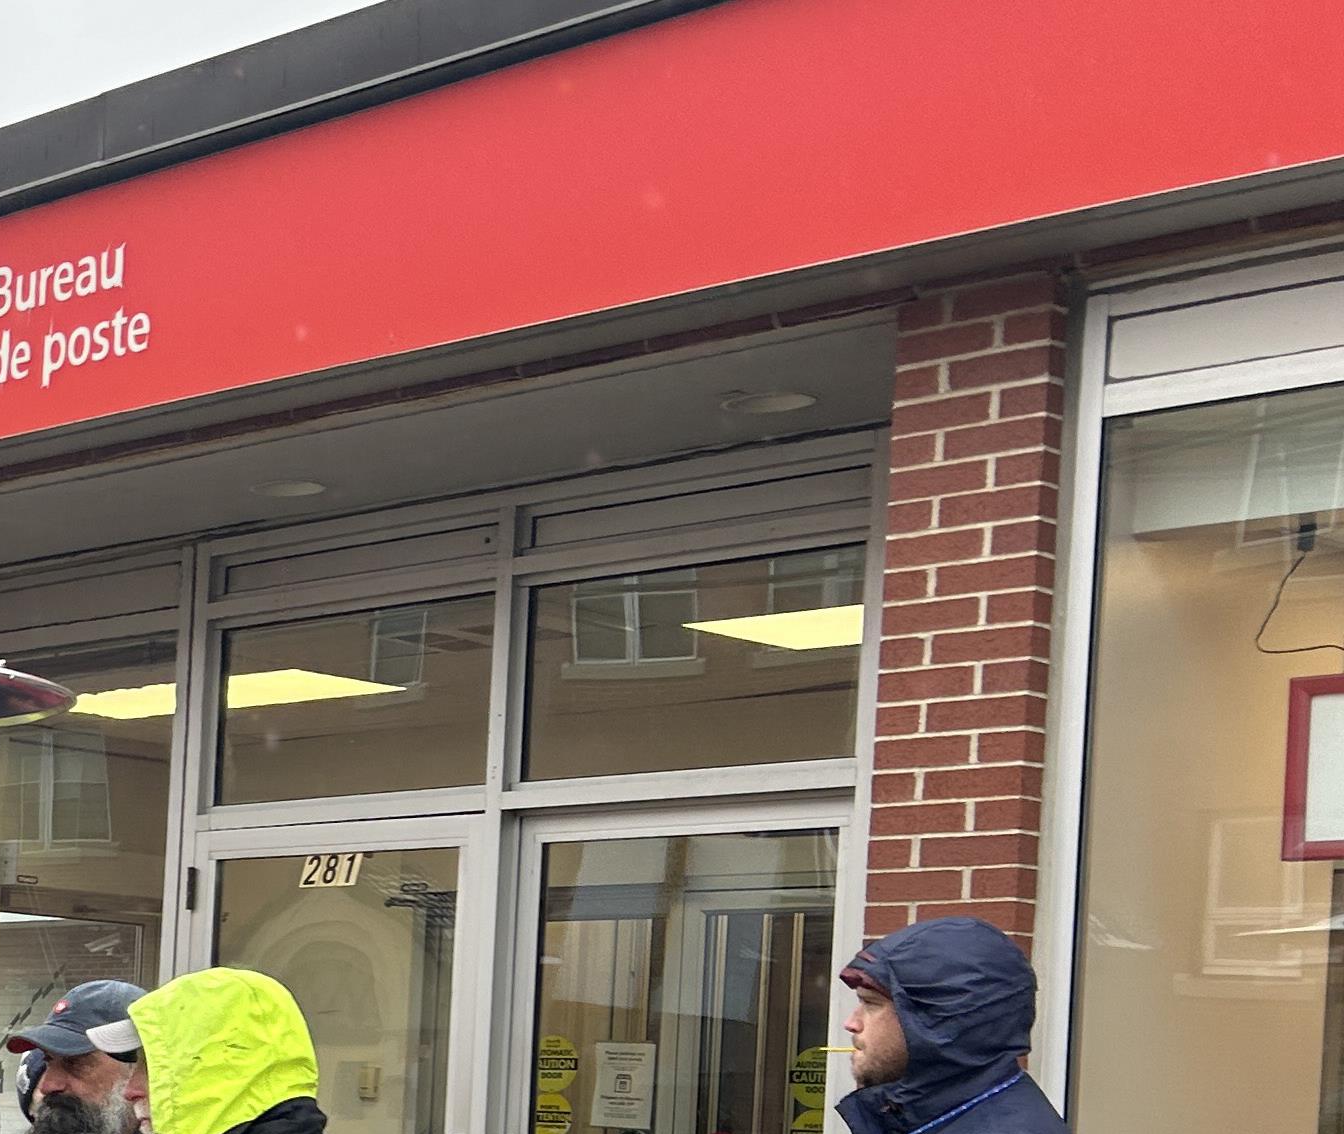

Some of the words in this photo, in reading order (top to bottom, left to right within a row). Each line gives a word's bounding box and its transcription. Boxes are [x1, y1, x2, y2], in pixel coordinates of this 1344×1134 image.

[42, 309, 152, 388] poste
[302, 854, 359, 887] 281
[539, 1059, 576, 1070] AUTION
[793, 1071, 826, 1084] CAUT
[805, 1086, 826, 1094] DOO
